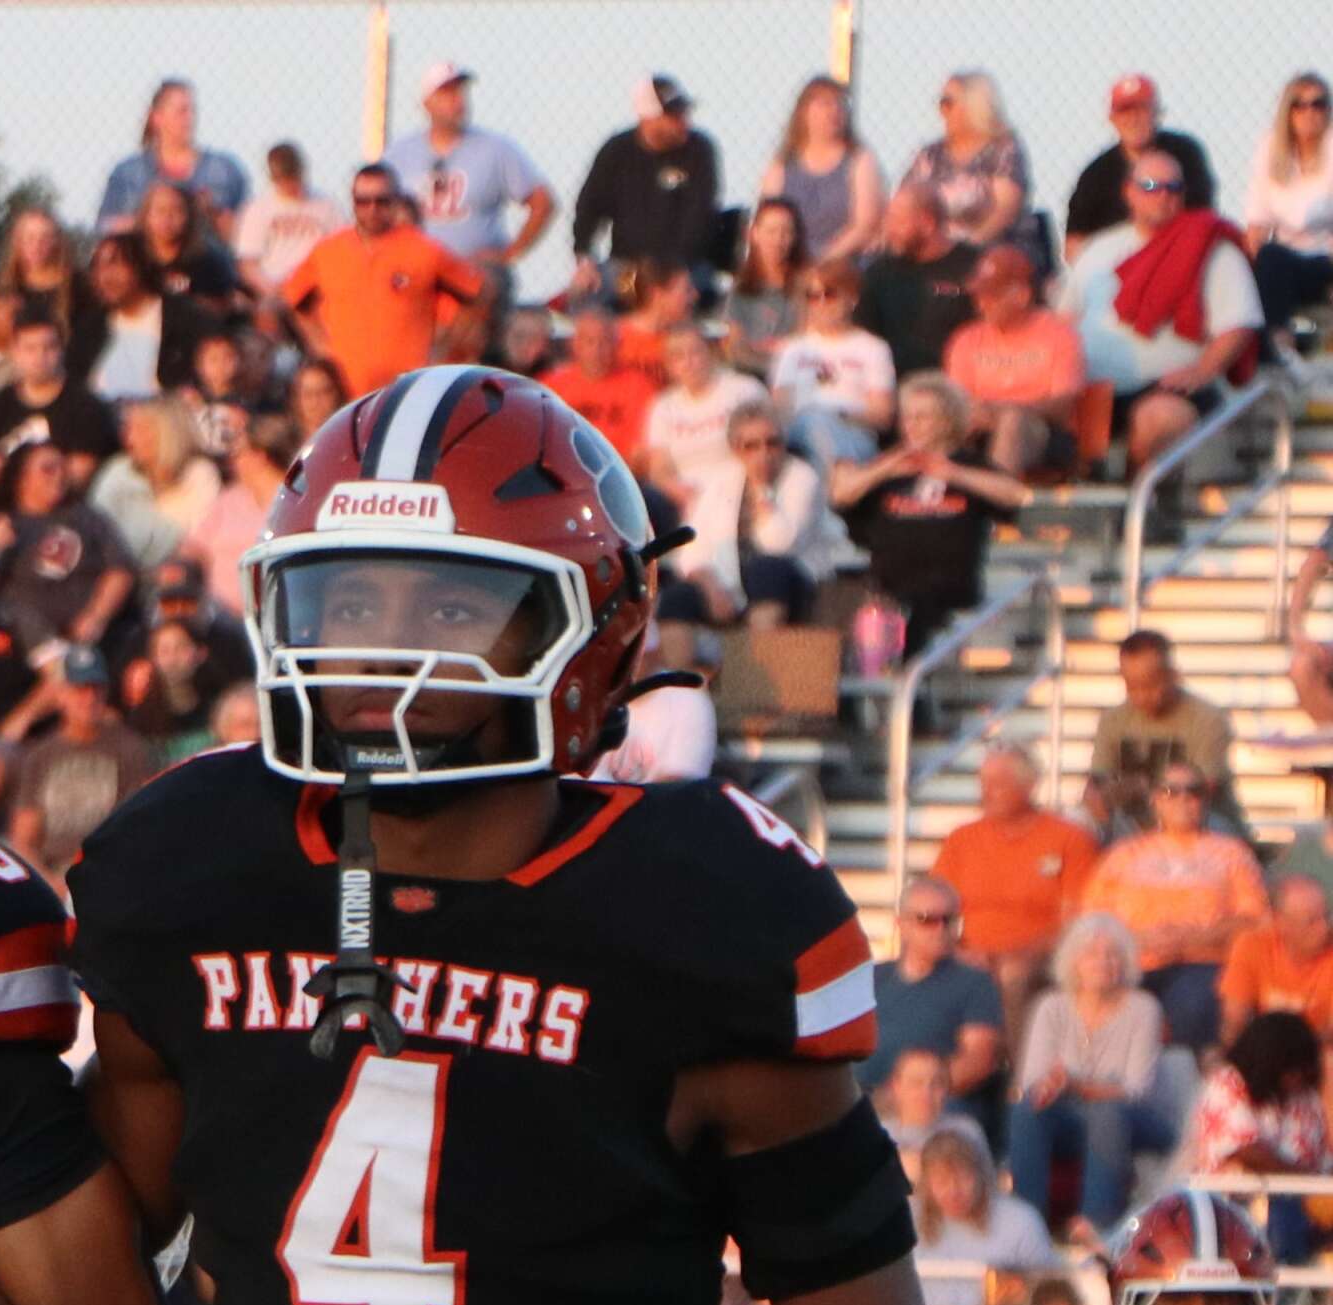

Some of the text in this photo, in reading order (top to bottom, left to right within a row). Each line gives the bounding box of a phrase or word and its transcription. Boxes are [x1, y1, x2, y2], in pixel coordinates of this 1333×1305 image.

[330, 493, 439, 519] Riddell
[339, 868, 372, 949] NXTRND
[190, 950, 590, 1066] PANHERS
